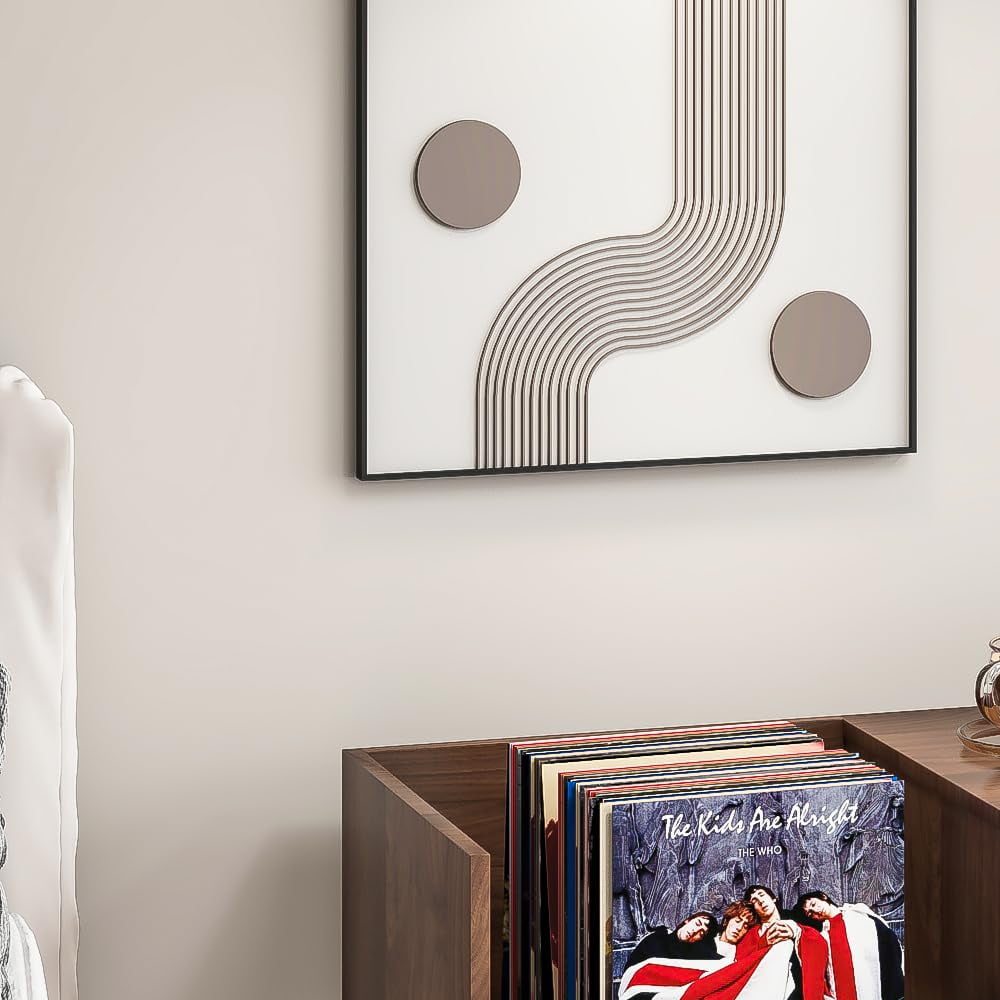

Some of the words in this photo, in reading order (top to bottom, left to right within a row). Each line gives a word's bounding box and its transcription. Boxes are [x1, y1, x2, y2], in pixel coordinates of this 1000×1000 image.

[662, 814, 691, 840] The
[696, 808, 745, 836] Kids
[749, 807, 782, 833] Are
[786, 800, 859, 834] Alright
[738, 847, 755, 858] THE
[757, 845, 782, 856] WHO
